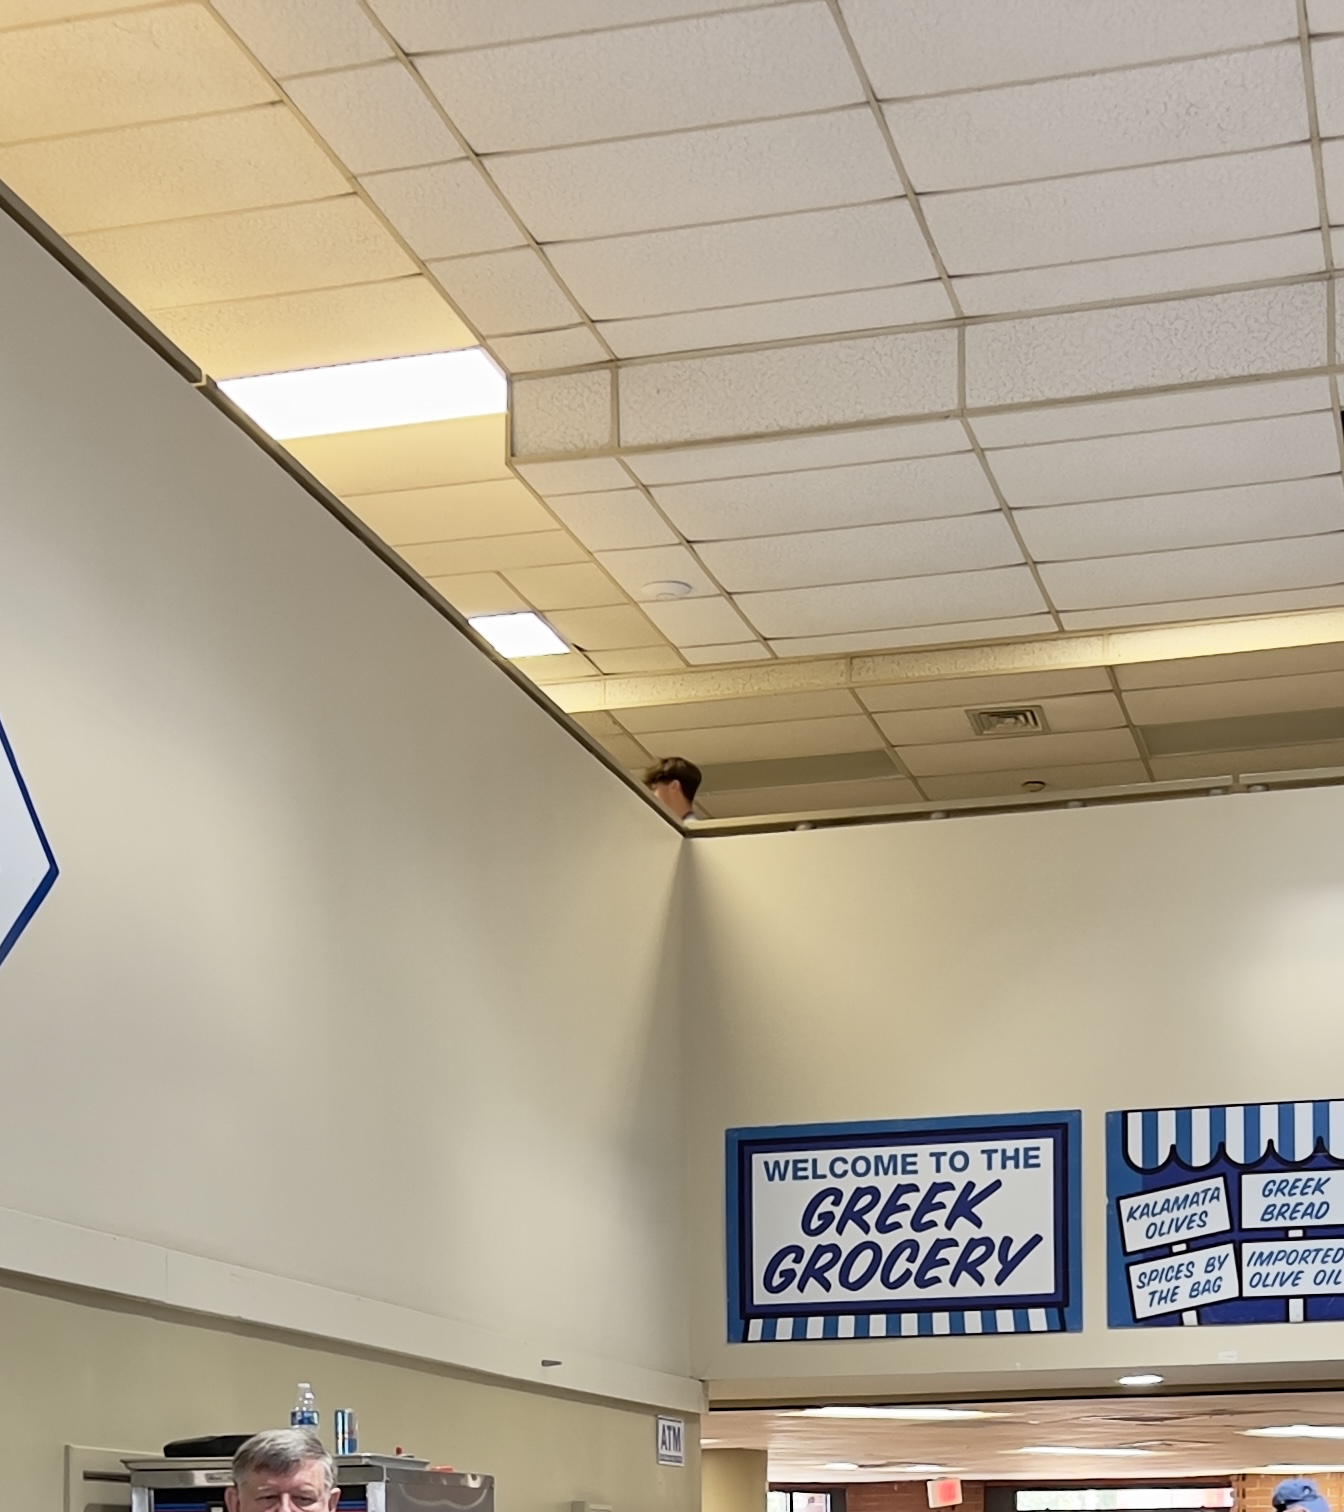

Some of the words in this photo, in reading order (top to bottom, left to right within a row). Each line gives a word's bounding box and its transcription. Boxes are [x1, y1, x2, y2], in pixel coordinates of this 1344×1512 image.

[763, 1153, 919, 1182] WELCOME
[929, 1150, 970, 1174] TO
[981, 1146, 1042, 1171] THE
[1261, 1177, 1331, 1198] GREEK
[801, 1178, 1002, 1237] GREEK
[1126, 1186, 1222, 1224] KALAMATA
[1260, 1200, 1330, 1222] BREAD
[1145, 1210, 1209, 1240] OLIVES
[762, 1233, 1043, 1295] GROCERY
[1135, 1260, 1195, 1291] SPICES
[1203, 1253, 1230, 1273] BY
[1248, 1270, 1303, 1289] OLIVE
[1313, 1268, 1344, 1287] OIL
[1148, 1286, 1181, 1309] THE
[1189, 1276, 1224, 1298] BAG
[660, 1423, 681, 1453] ATM
